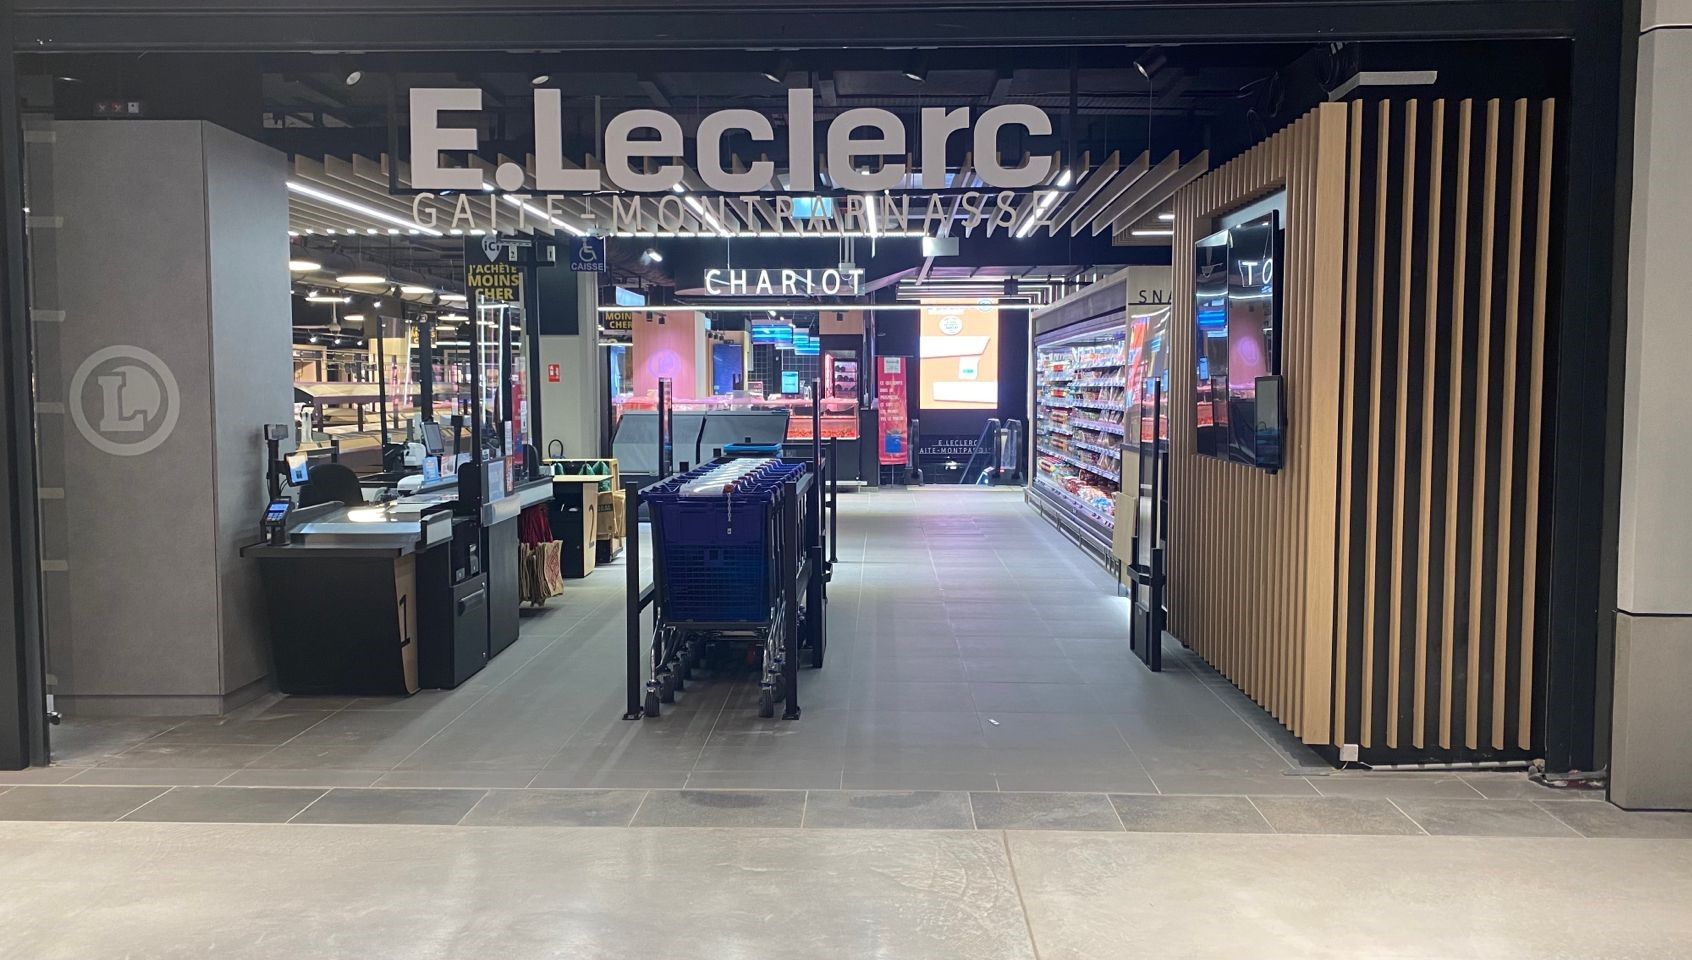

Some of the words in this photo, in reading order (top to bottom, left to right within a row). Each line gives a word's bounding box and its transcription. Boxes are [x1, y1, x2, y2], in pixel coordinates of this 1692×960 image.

[409, 87, 1053, 192] E.Leclerc
[571, 262, 604, 271] CAISSE
[467, 273, 520, 287] MOINS
[705, 269, 864, 295] CHARIOT
[475, 288, 514, 300] CHER
[605, 311, 632, 321] MOIN
